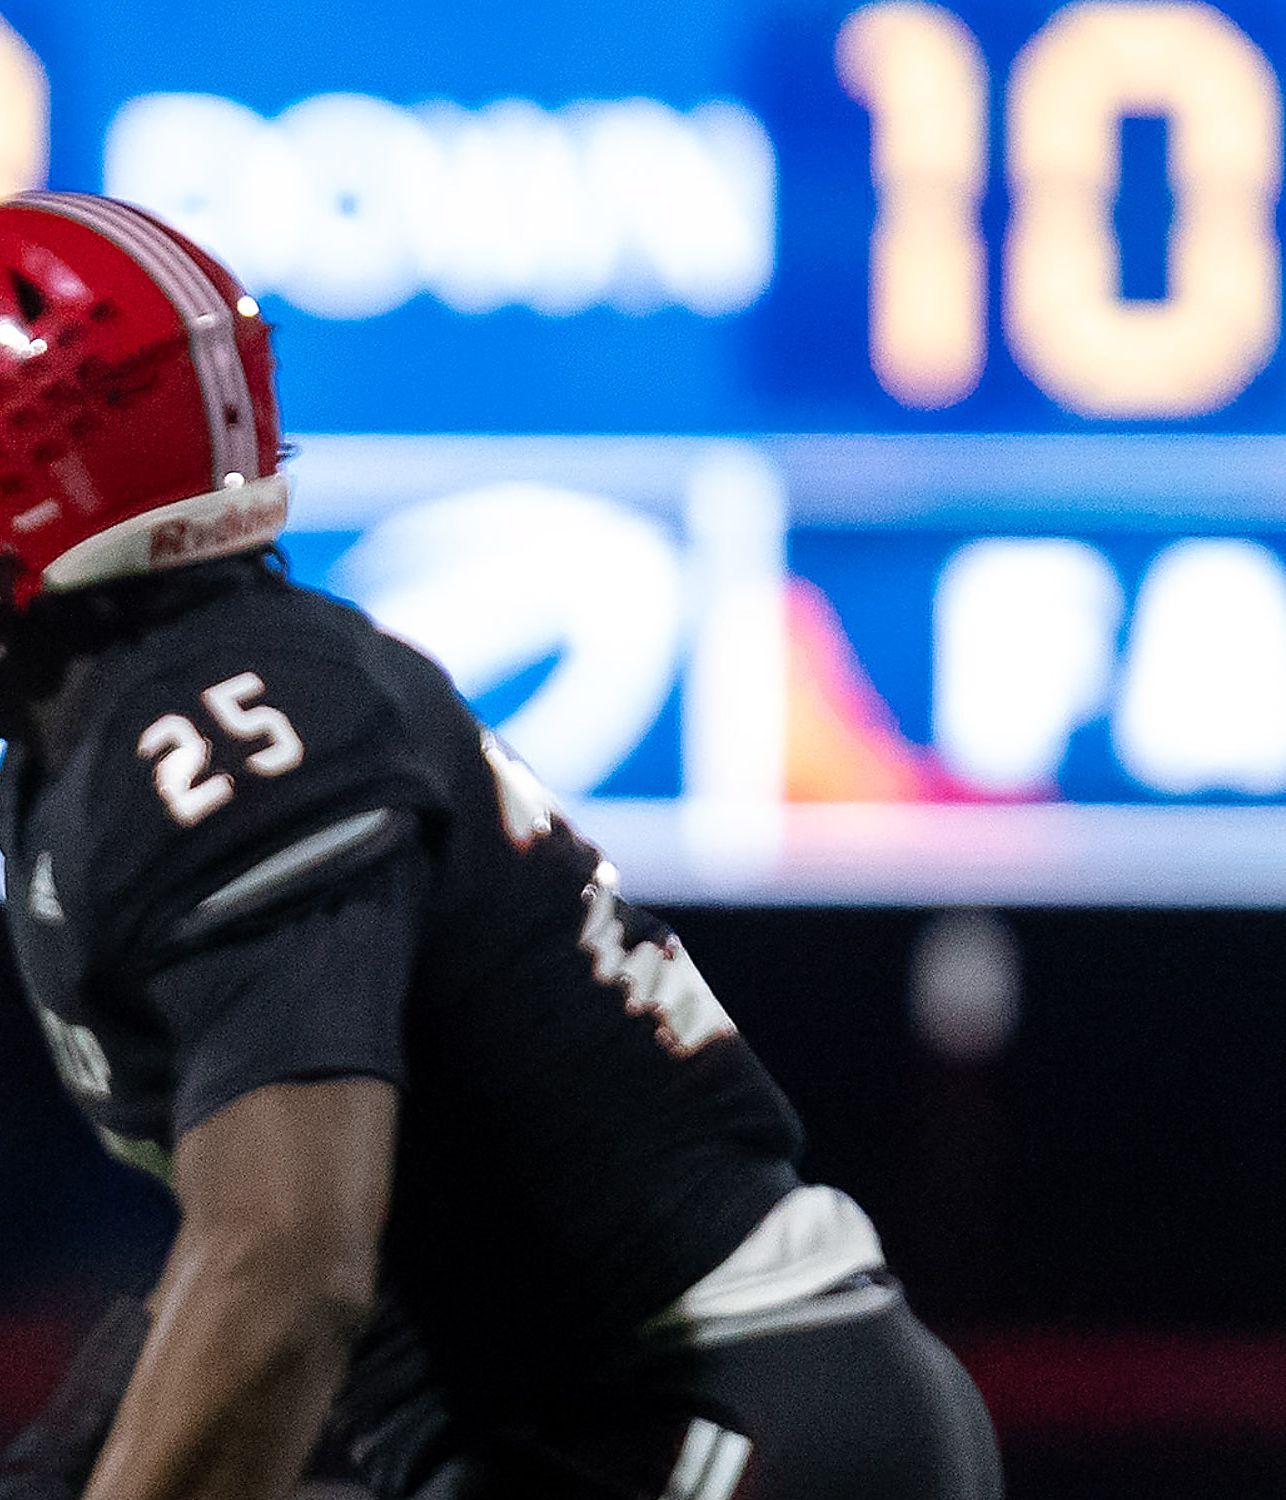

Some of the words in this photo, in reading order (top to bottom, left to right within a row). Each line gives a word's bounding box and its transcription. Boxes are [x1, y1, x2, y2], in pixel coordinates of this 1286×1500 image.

[105, 92, 777, 316] DOWN
[841, 0, 1281, 418] 10
[136, 671, 305, 828] 25
